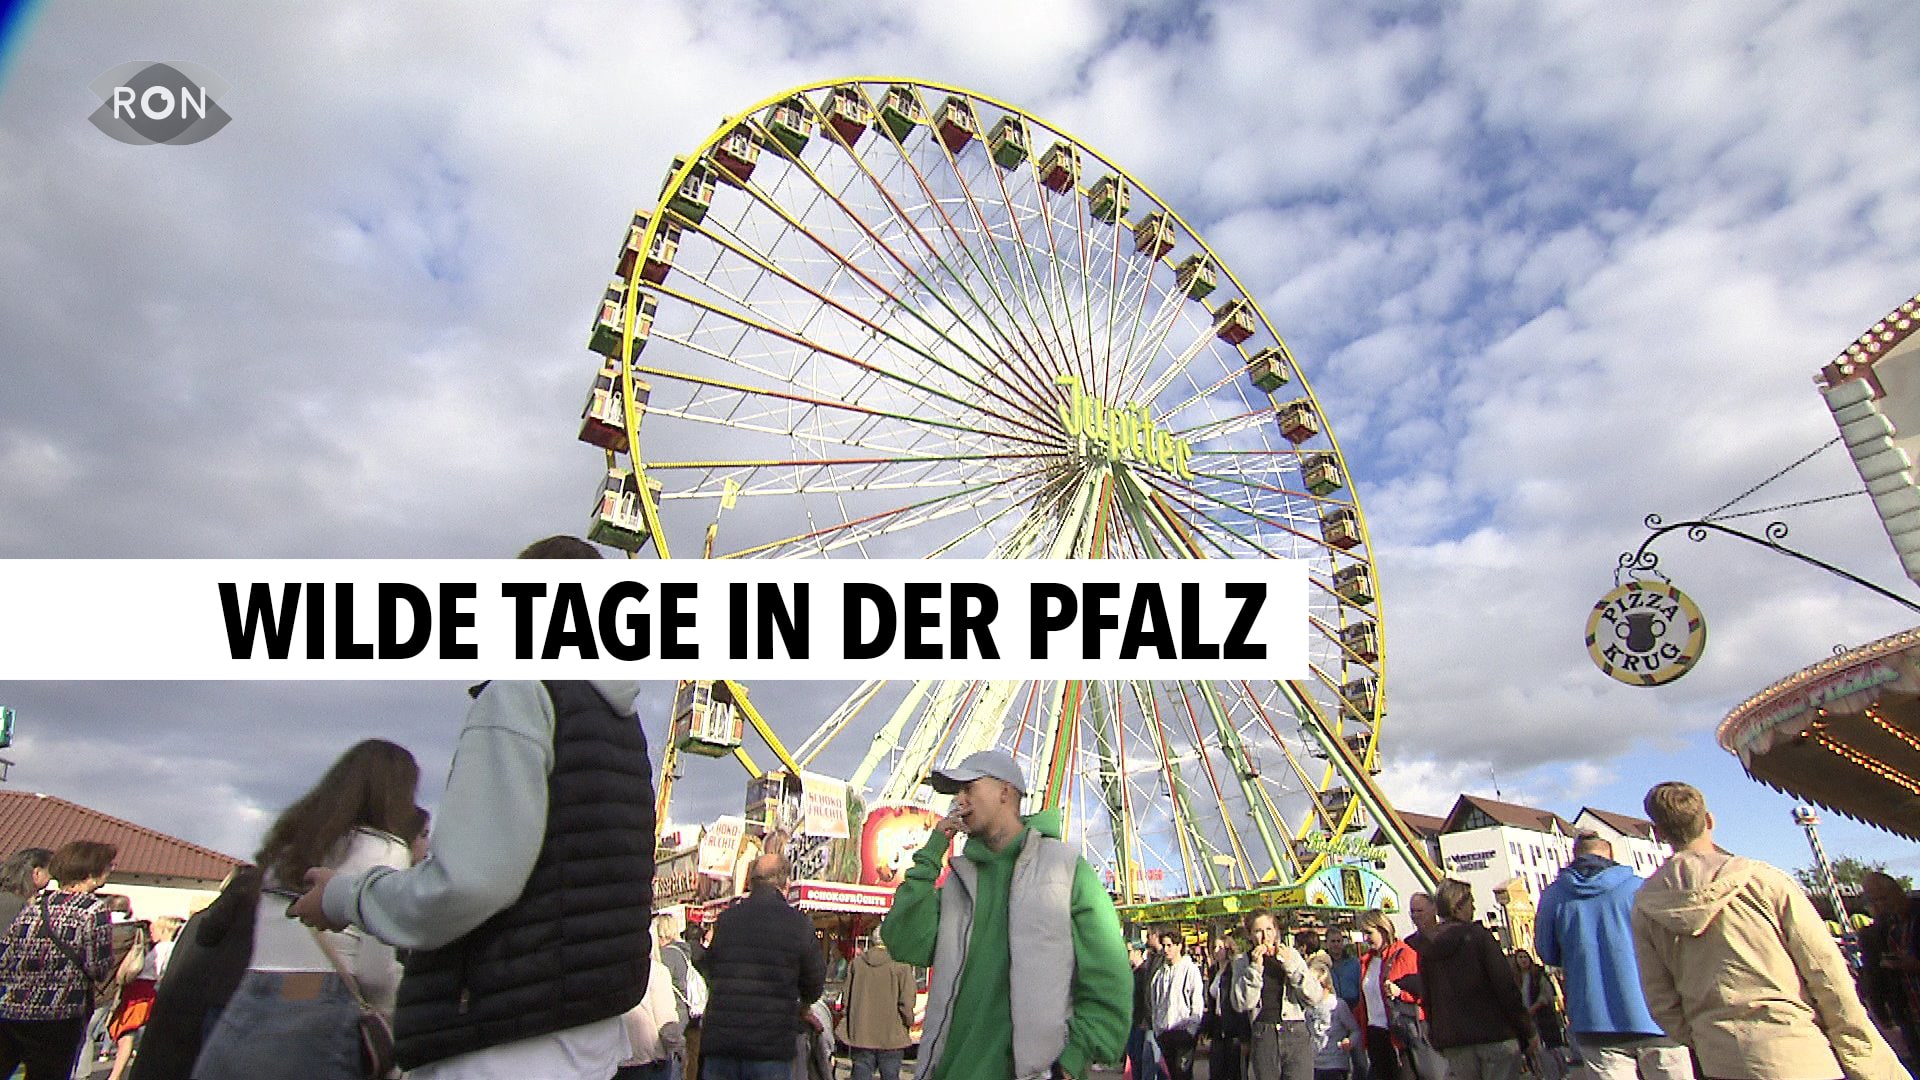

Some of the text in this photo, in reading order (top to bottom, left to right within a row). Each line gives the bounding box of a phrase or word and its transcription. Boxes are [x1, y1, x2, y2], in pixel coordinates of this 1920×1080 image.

[1054, 374, 1195, 481] Jupiter
[1601, 593, 1680, 624] PIZZA
[1602, 642, 1681, 671] KRUG
